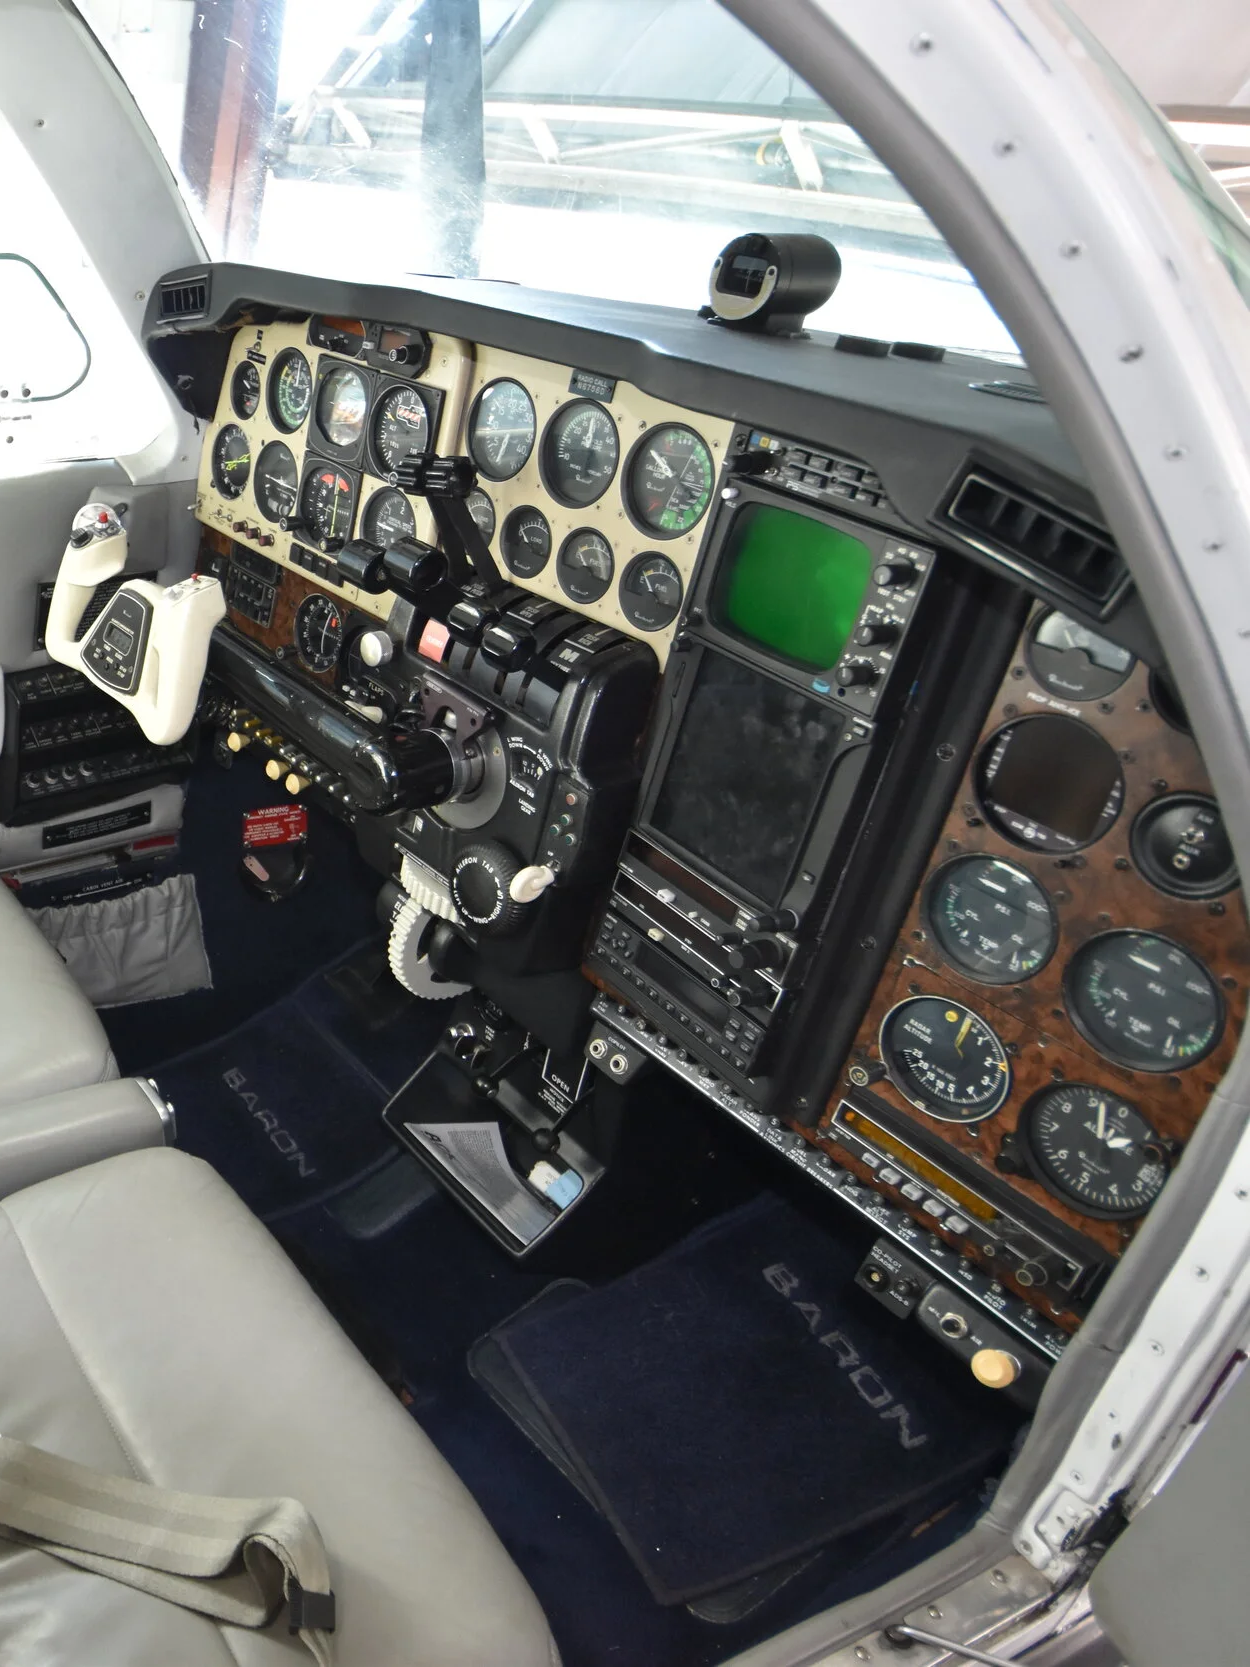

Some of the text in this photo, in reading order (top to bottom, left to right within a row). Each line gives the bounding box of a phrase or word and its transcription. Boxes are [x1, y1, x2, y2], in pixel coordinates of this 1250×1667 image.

[594, 379, 607, 388] CALL
[655, 583, 668, 593] FUEL
[558, 648, 580, 664] M
[368, 682, 384, 696] FLAPS
[510, 779, 526, 792] AILERON
[257, 806, 289, 816] WARNING
[518, 798, 536, 813] LANDING
[1179, 844, 1200, 856] AUX
[455, 856, 478, 874] AILERON
[481, 860, 494, 874] TAB
[490, 902, 503, 920] RIGHT
[978, 935, 999, 948] TEMP
[1011, 934, 1024, 945] OIL
[909, 1018, 933, 1035] RADAR
[1128, 1016, 1152, 1032] TEMP
[1166, 1016, 1181, 1030] OIL
[903, 1024, 934, 1045] ALTITUDE
[977, 1036, 984, 1046] 1
[912, 1048, 924, 1059] 25
[918, 1060, 930, 1070] 20
[984, 1057, 993, 1068] 2
[926, 1071, 936, 1081] 15
[980, 1076, 990, 1086] 3
[552, 1074, 570, 1093] OPEN
[935, 1078, 946, 1090] 10
[947, 1084, 956, 1093] 5
[966, 1086, 975, 1095] 4
[721, 1098, 733, 1107] ALT
[1062, 1102, 1072, 1114] 8
[1087, 1097, 1098, 1108] 9
[739, 1110, 760, 1127] PONDER
[1118, 1107, 1128, 1118] 0
[222, 1067, 316, 1179] BARON
[1050, 1122, 1060, 1132] 7
[766, 1128, 782, 1142] DATA
[1058, 1150, 1069, 1160] 6
[786, 1151, 807, 1169] CIRCUIT
[806, 1167, 834, 1190] BREAKERS
[1080, 1172, 1090, 1184] 5
[1108, 1184, 1119, 1195] 4
[1132, 1180, 1144, 1192] 3
[870, 1252, 900, 1274] HEADSET
[872, 1246, 902, 1268] CO-PILOT
[984, 1294, 1004, 1310] PILOT
[761, 1262, 928, 1451] BARON
